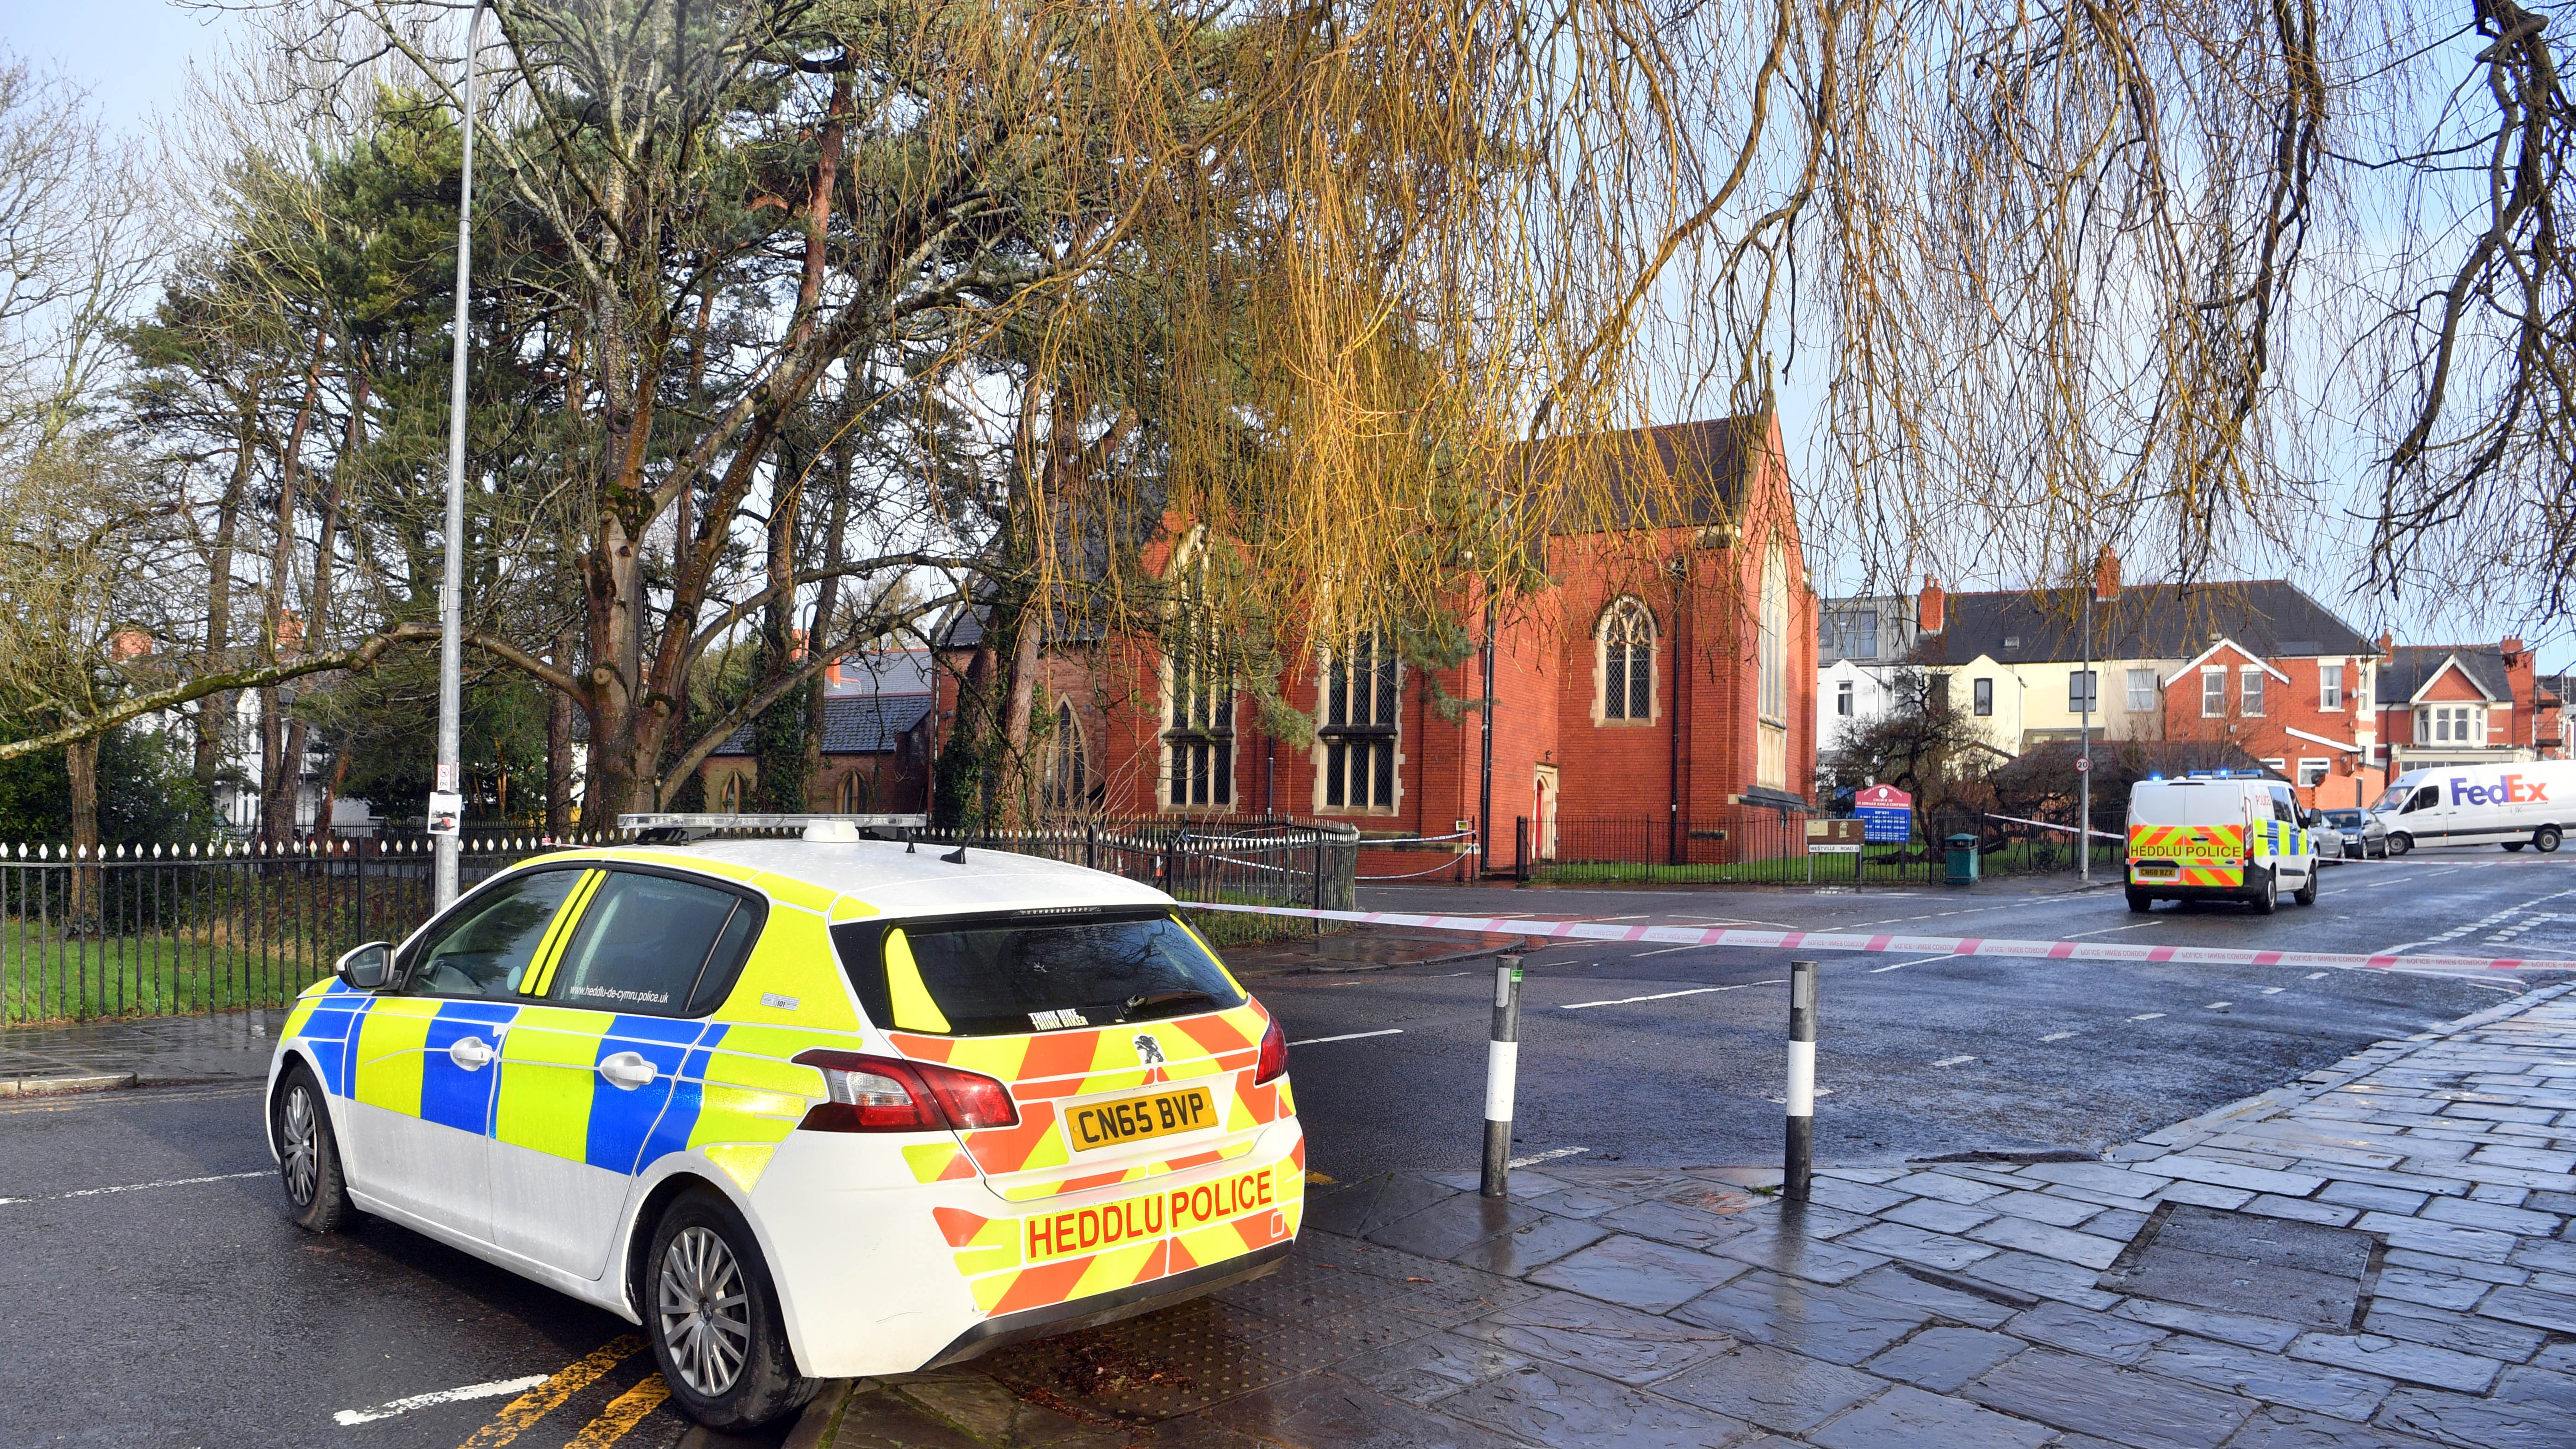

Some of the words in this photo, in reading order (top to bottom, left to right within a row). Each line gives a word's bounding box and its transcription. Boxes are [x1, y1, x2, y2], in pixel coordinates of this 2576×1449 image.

[2450, 774, 2550, 805] FedEx
[2255, 795, 2271, 805] POLICE
[2510, 806, 2523, 815] UK
[2131, 846, 2181, 856] HEDDLU
[2186, 846, 2241, 857] POLICE
[570, 985, 669, 1003] www.heddlu-de-cymru.police.uk
[1028, 1010, 1058, 1022] THINK
[1056, 1009, 1079, 1018] BIKE
[1032, 1019, 1063, 1031] THINK
[1060, 1016, 1089, 1028] BIKER
[1078, 1104, 1153, 1143] CN65
[1156, 1093, 1203, 1129] BVP
[1029, 1196, 1162, 1258] HEDDLU
[1171, 1170, 1272, 1228] POLICE
